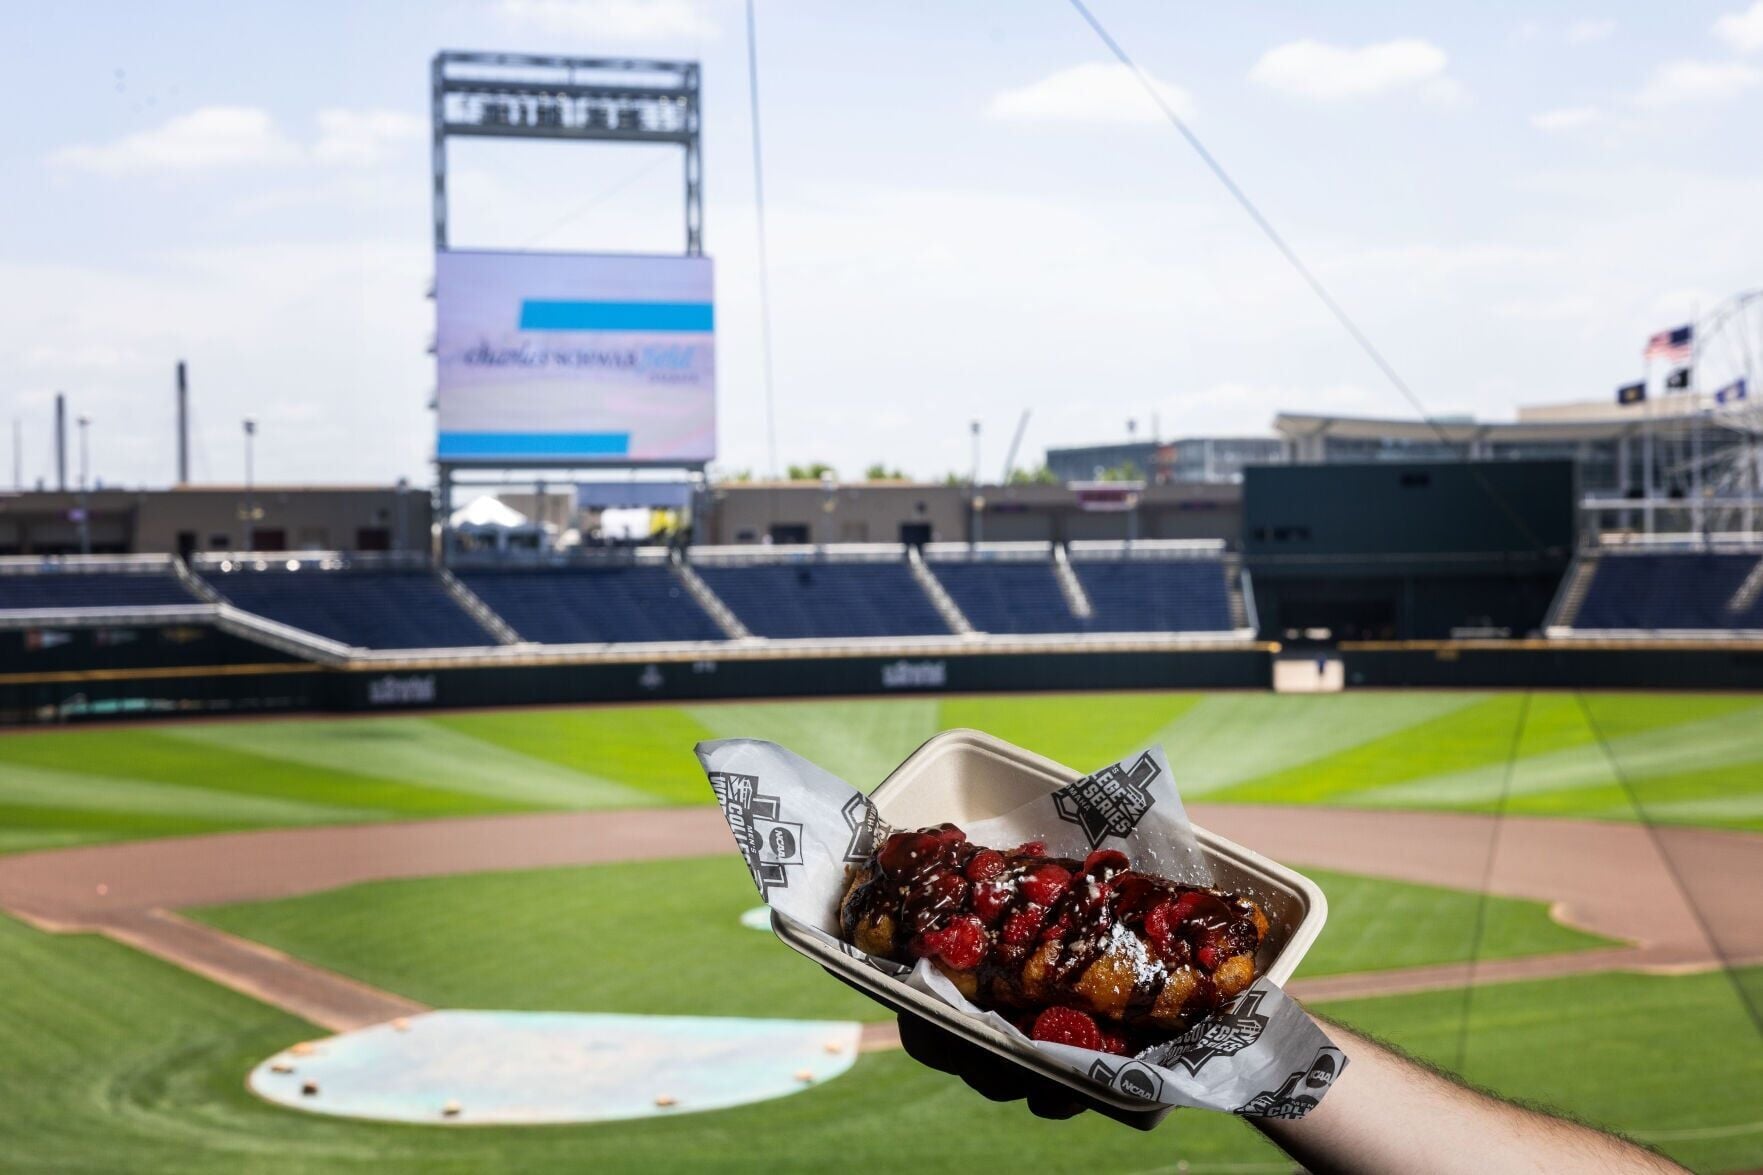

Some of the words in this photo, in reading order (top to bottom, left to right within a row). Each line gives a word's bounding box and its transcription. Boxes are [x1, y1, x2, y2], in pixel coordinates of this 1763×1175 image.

[1083, 783, 1132, 834] SERIES
[746, 824, 757, 854] MEN'S
[774, 828, 786, 859] NCAA
[1121, 1079, 1152, 1100] NCAA
